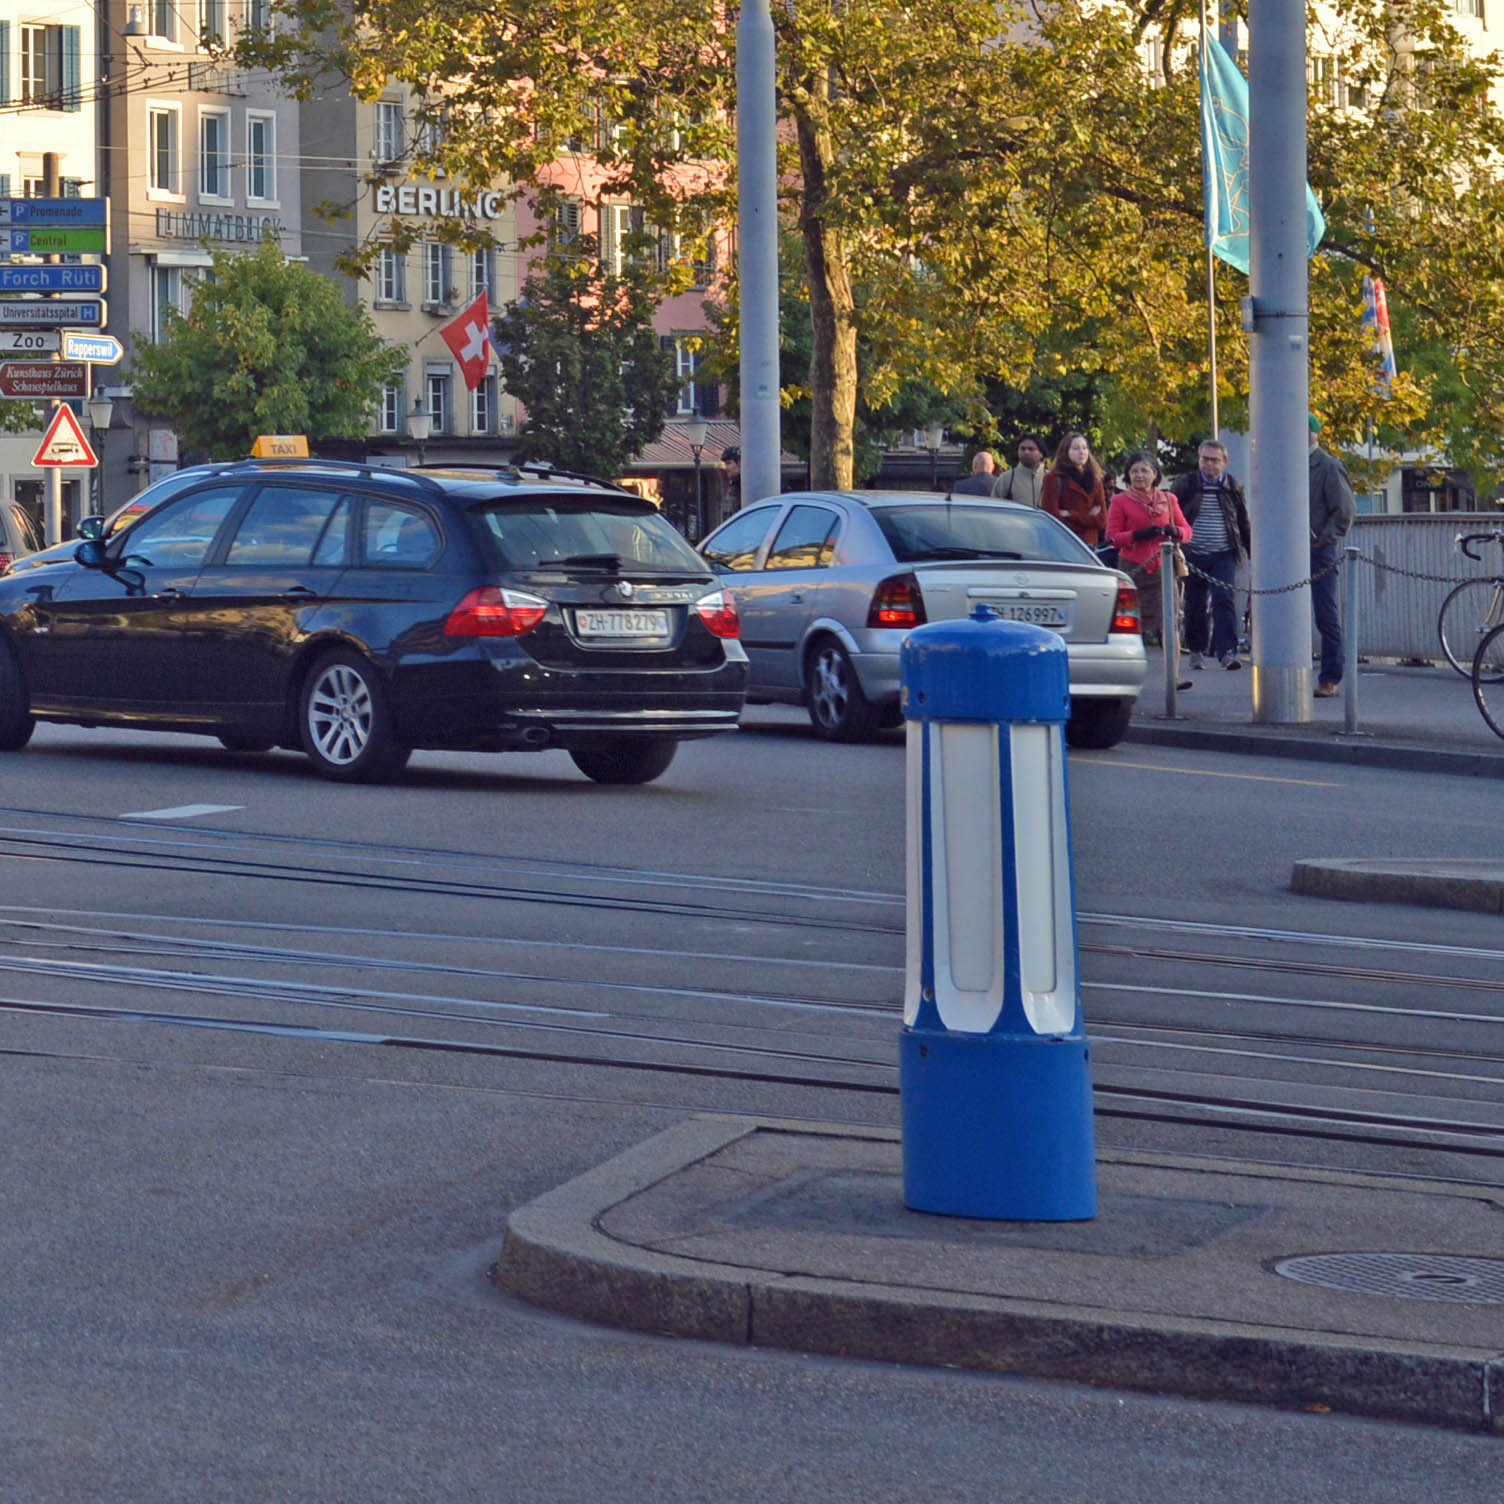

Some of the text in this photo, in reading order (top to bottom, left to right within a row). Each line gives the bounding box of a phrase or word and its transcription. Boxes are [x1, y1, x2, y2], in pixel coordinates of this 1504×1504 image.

[30, 205, 83, 217] Promenade
[30, 234, 67, 247] Central
[2, 269, 97, 286] Forch Rüti
[2, 306, 79, 321] Universitätsspital
[12, 333, 45, 348] Zoo
[68, 337, 113, 359] Rapperswil
[6, 366, 84, 378] Kunsthaus Zürich
[12, 380, 78, 394] Schauspielhaus
[271, 444, 297, 455] TAXI
[1009, 607, 1057, 622] 126997
